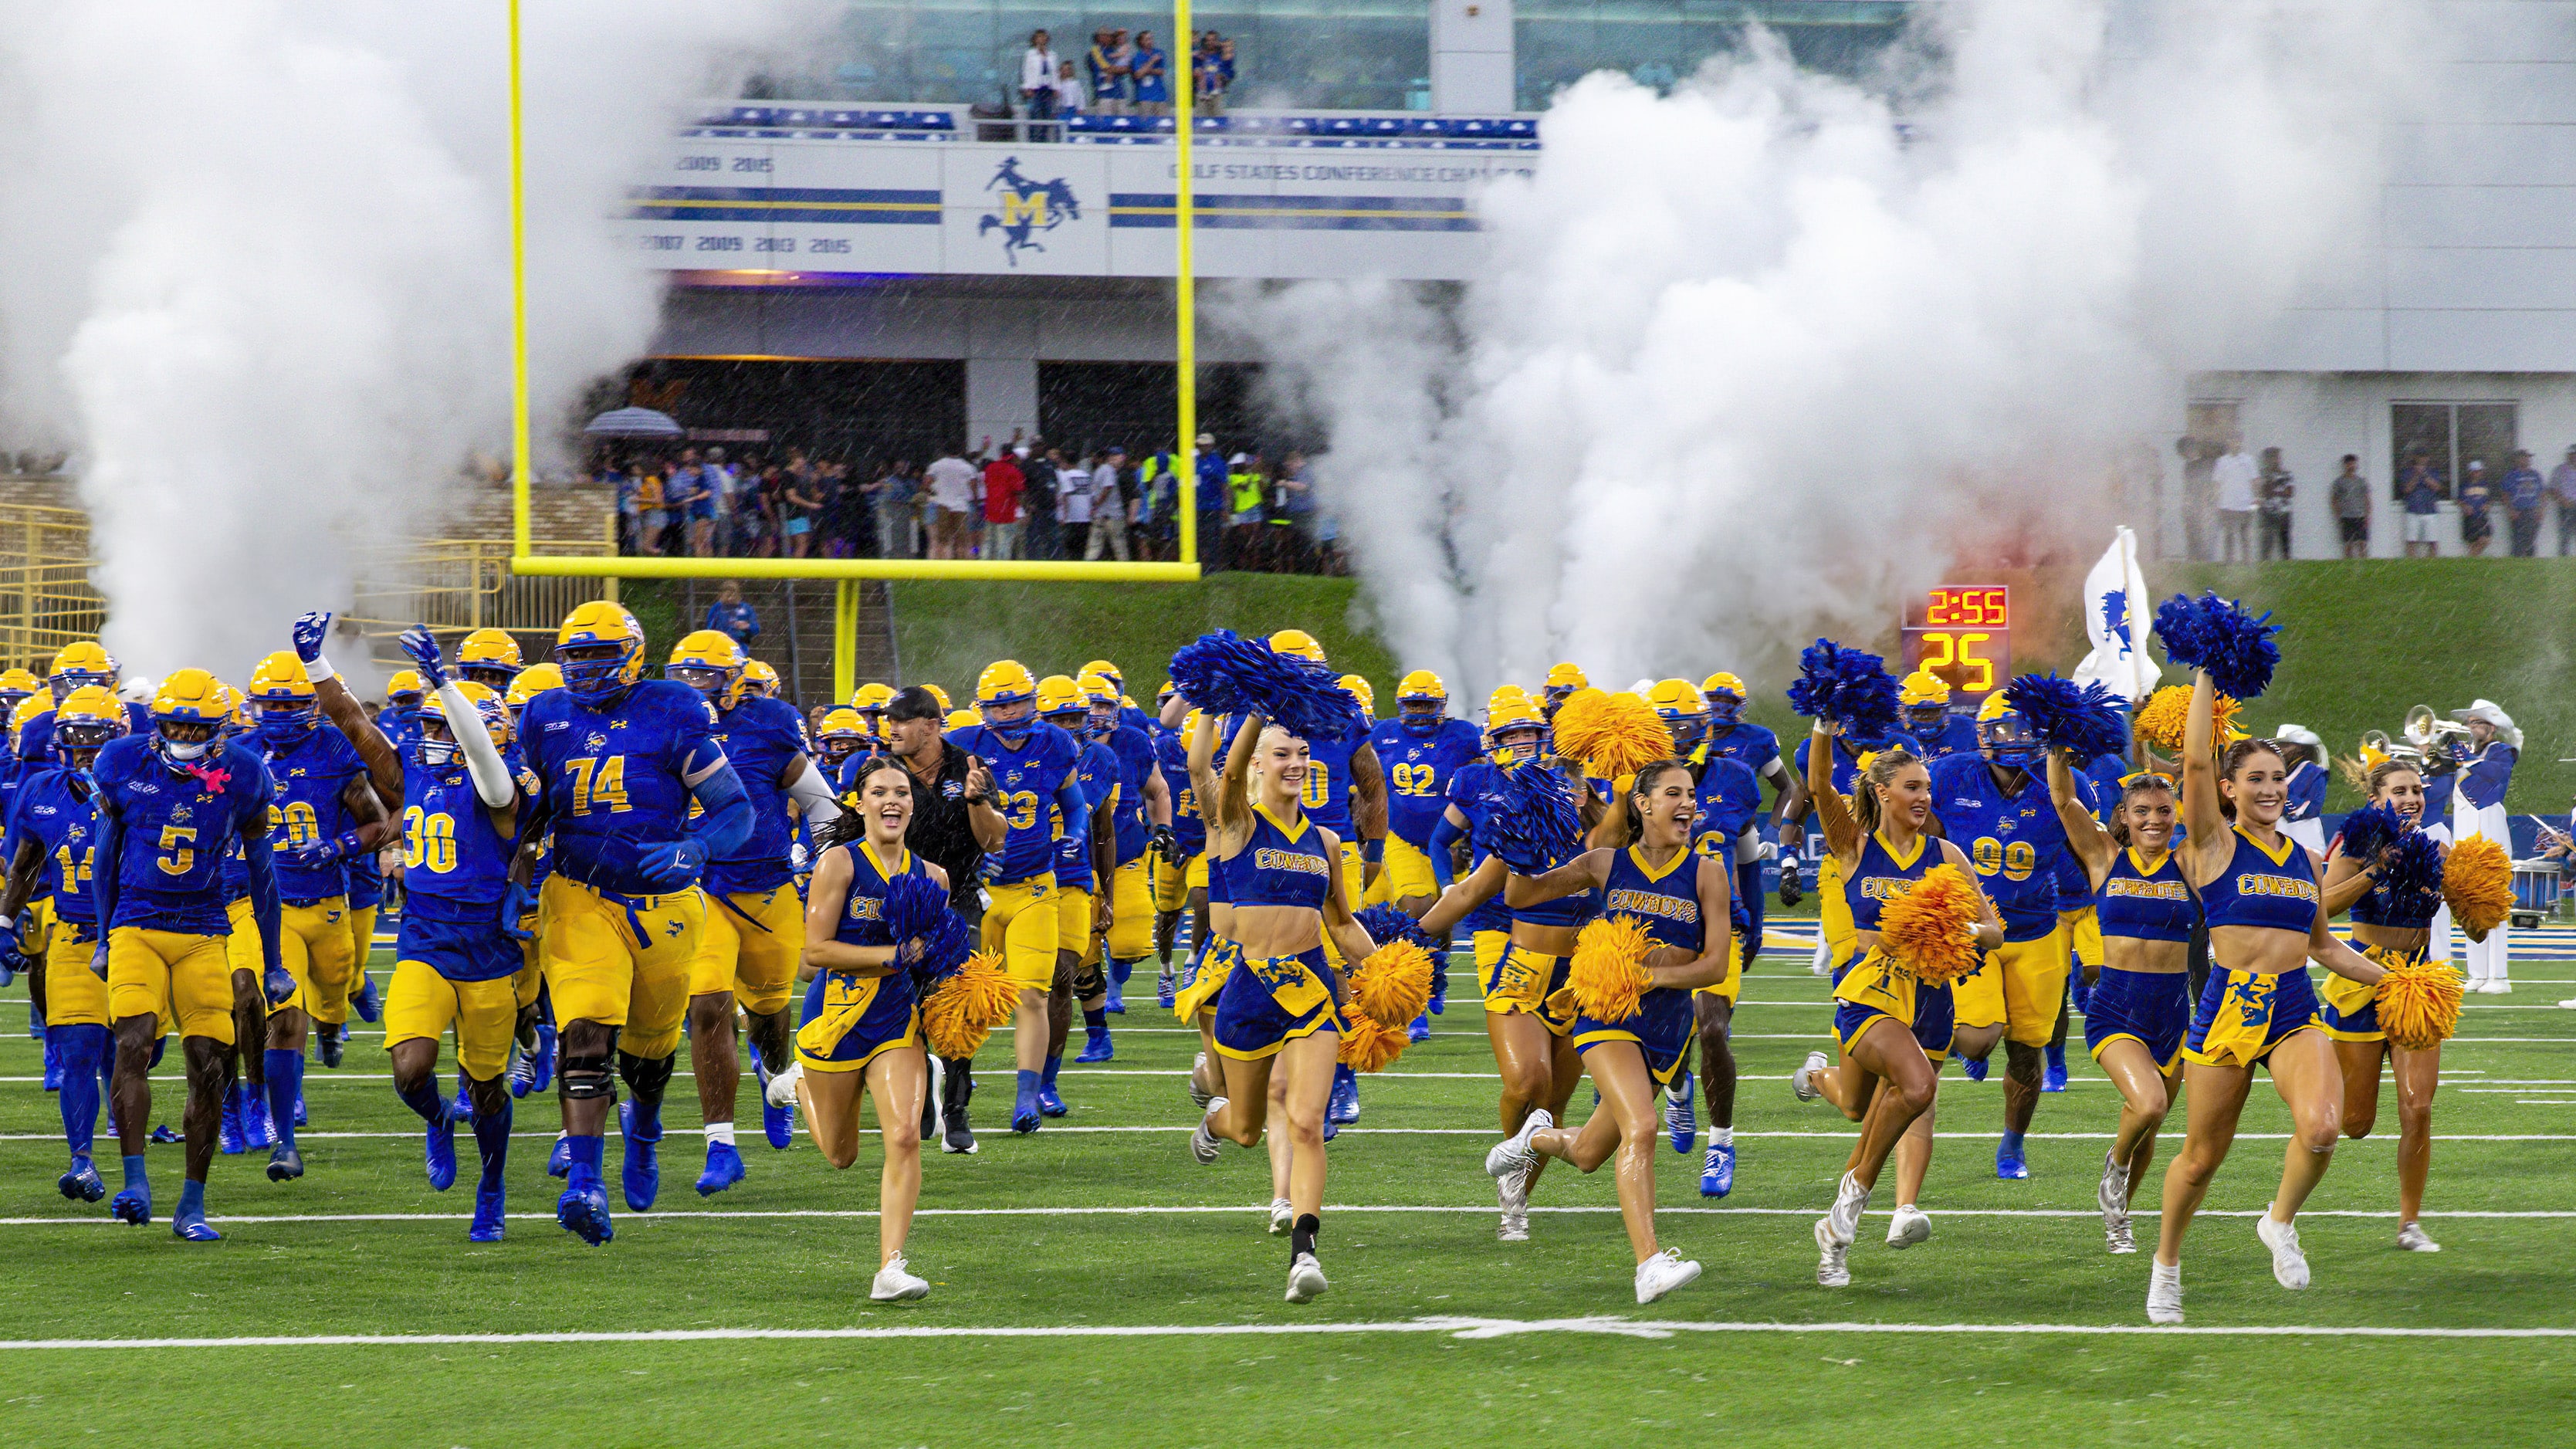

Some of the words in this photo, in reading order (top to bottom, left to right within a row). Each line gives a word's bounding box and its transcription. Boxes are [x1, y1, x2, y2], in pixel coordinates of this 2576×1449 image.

[1168, 164, 1221, 178] GLF
[1224, 165, 1299, 180] STATES
[1302, 166, 1435, 182] CONFERENCE
[1001, 191, 1048, 226] M
[1928, 591, 2005, 624] 2:55
[1919, 633, 1993, 691] 25
[565, 755, 633, 817] 74
[1393, 763, 1437, 796] 92
[157, 824, 197, 875] 5
[403, 805, 458, 874] 30
[1972, 836, 2036, 881] 99
